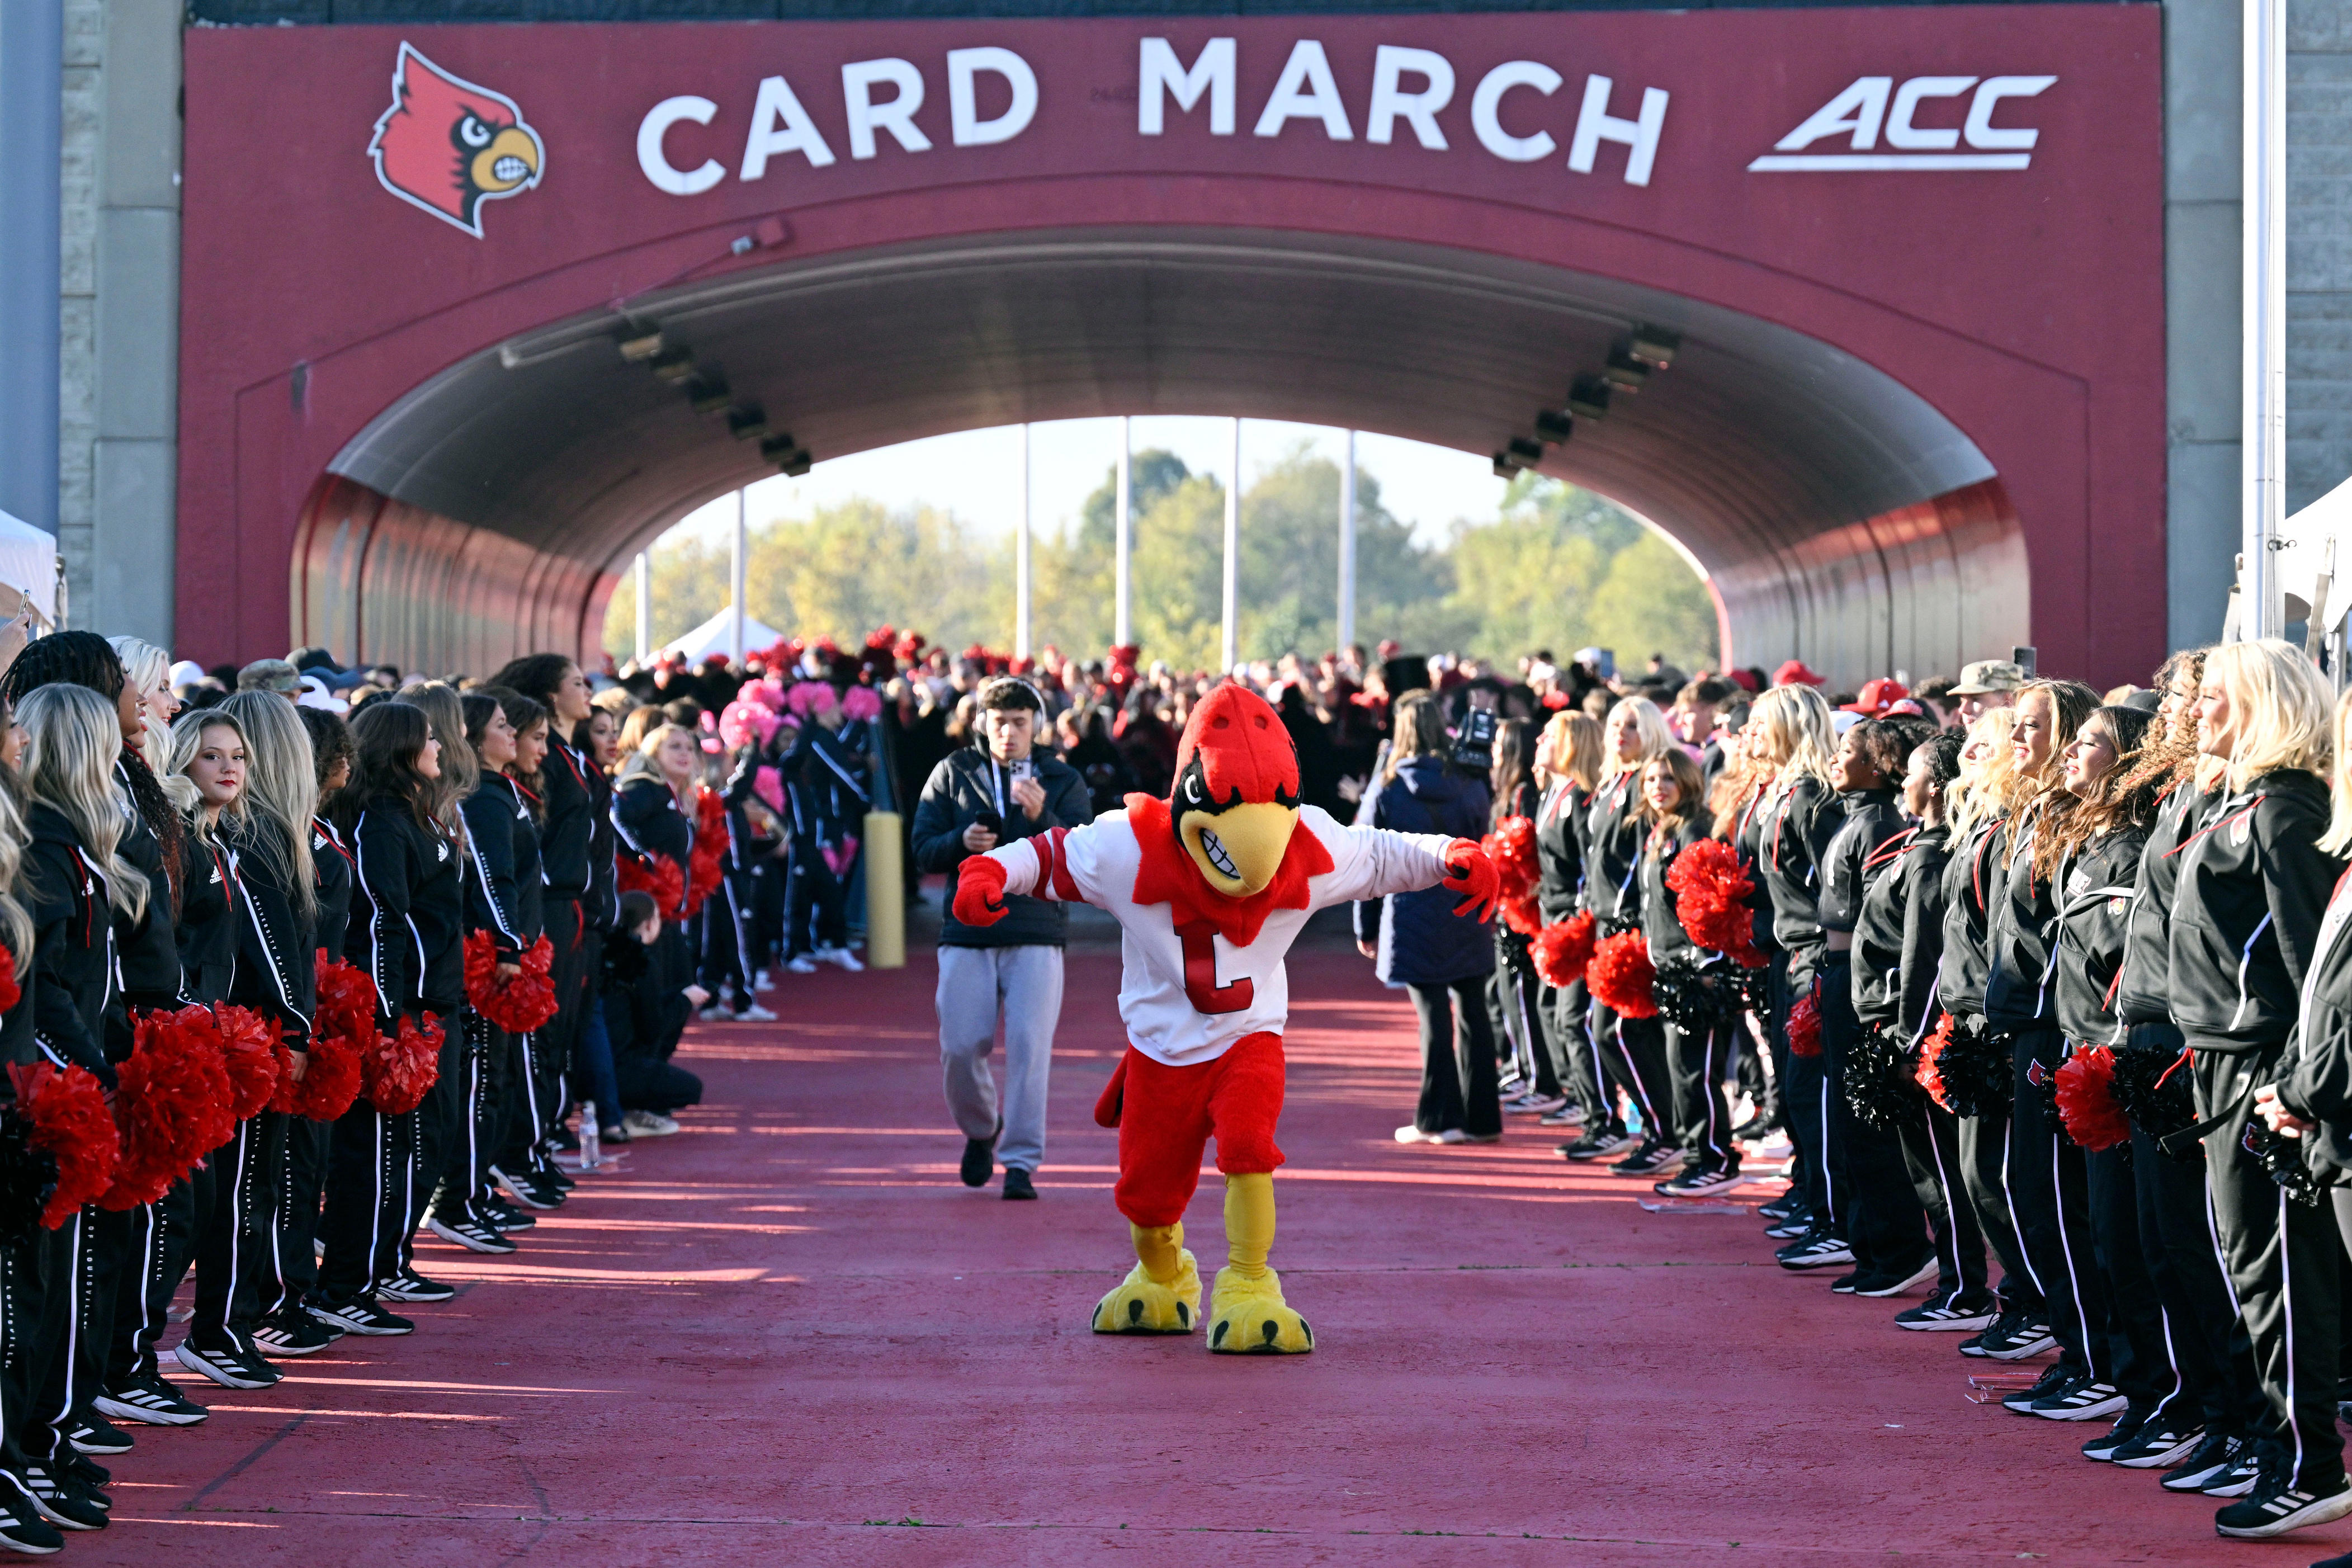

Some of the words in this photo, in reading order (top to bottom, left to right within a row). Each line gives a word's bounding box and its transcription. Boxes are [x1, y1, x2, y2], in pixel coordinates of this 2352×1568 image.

[636, 46, 1040, 196] CARD
[1137, 36, 1670, 187] MARCH
[1773, 75, 2060, 151] ACC
[253, 895, 277, 951] UNIVERSITY
[276, 955, 283, 966] OF
[281, 972, 294, 1006] LOUISV
[1173, 923, 1254, 1015] L
[250, 1154, 256, 1165] OF
[285, 1149, 290, 1161] OF
[88, 1225, 95, 1239] OF
